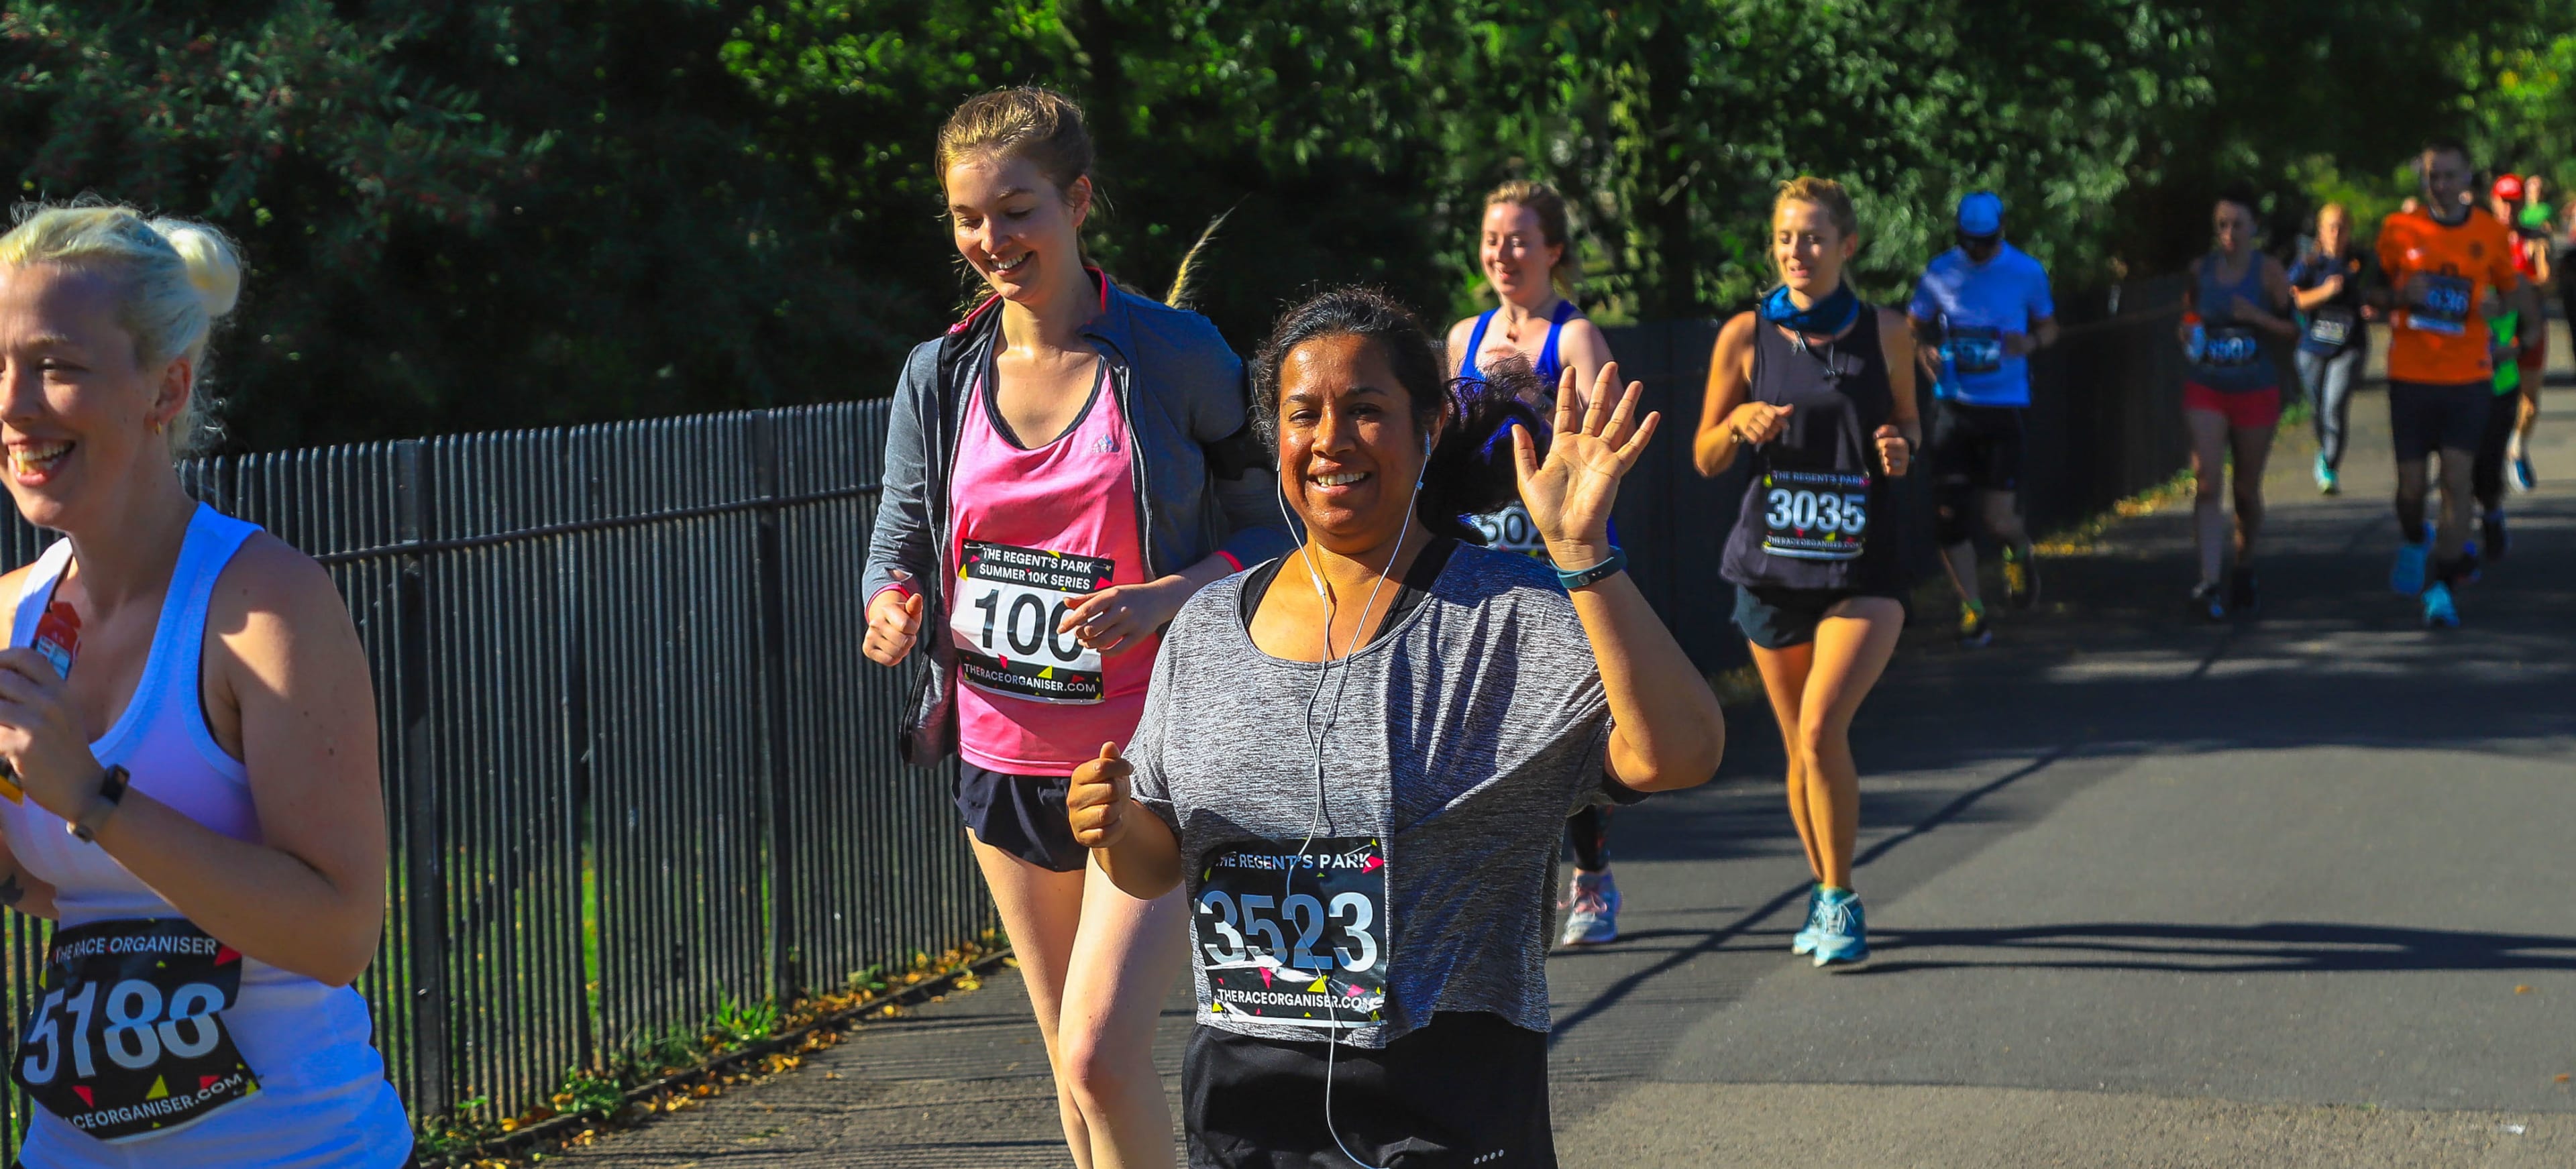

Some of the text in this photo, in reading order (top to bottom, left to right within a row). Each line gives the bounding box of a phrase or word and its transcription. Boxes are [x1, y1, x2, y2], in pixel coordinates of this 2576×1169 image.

[1839, 475, 1866, 485] PARK
[1766, 488, 1866, 535] 3035
[983, 547, 1092, 574] THE REGENT'S PARK
[979, 563, 1091, 590] SUMMER 10K SERIES
[964, 663, 1096, 693] THERACEORGANISER.COM
[1240, 854, 1313, 871] REGENT'S
[1320, 853, 1373, 869] PARK
[1199, 890, 1378, 972] 3523
[55, 936, 217, 964] THE RACE ORGANISER
[22, 979, 225, 1085] 5188
[64, 1073, 244, 1129] CEORGANISER.COM
